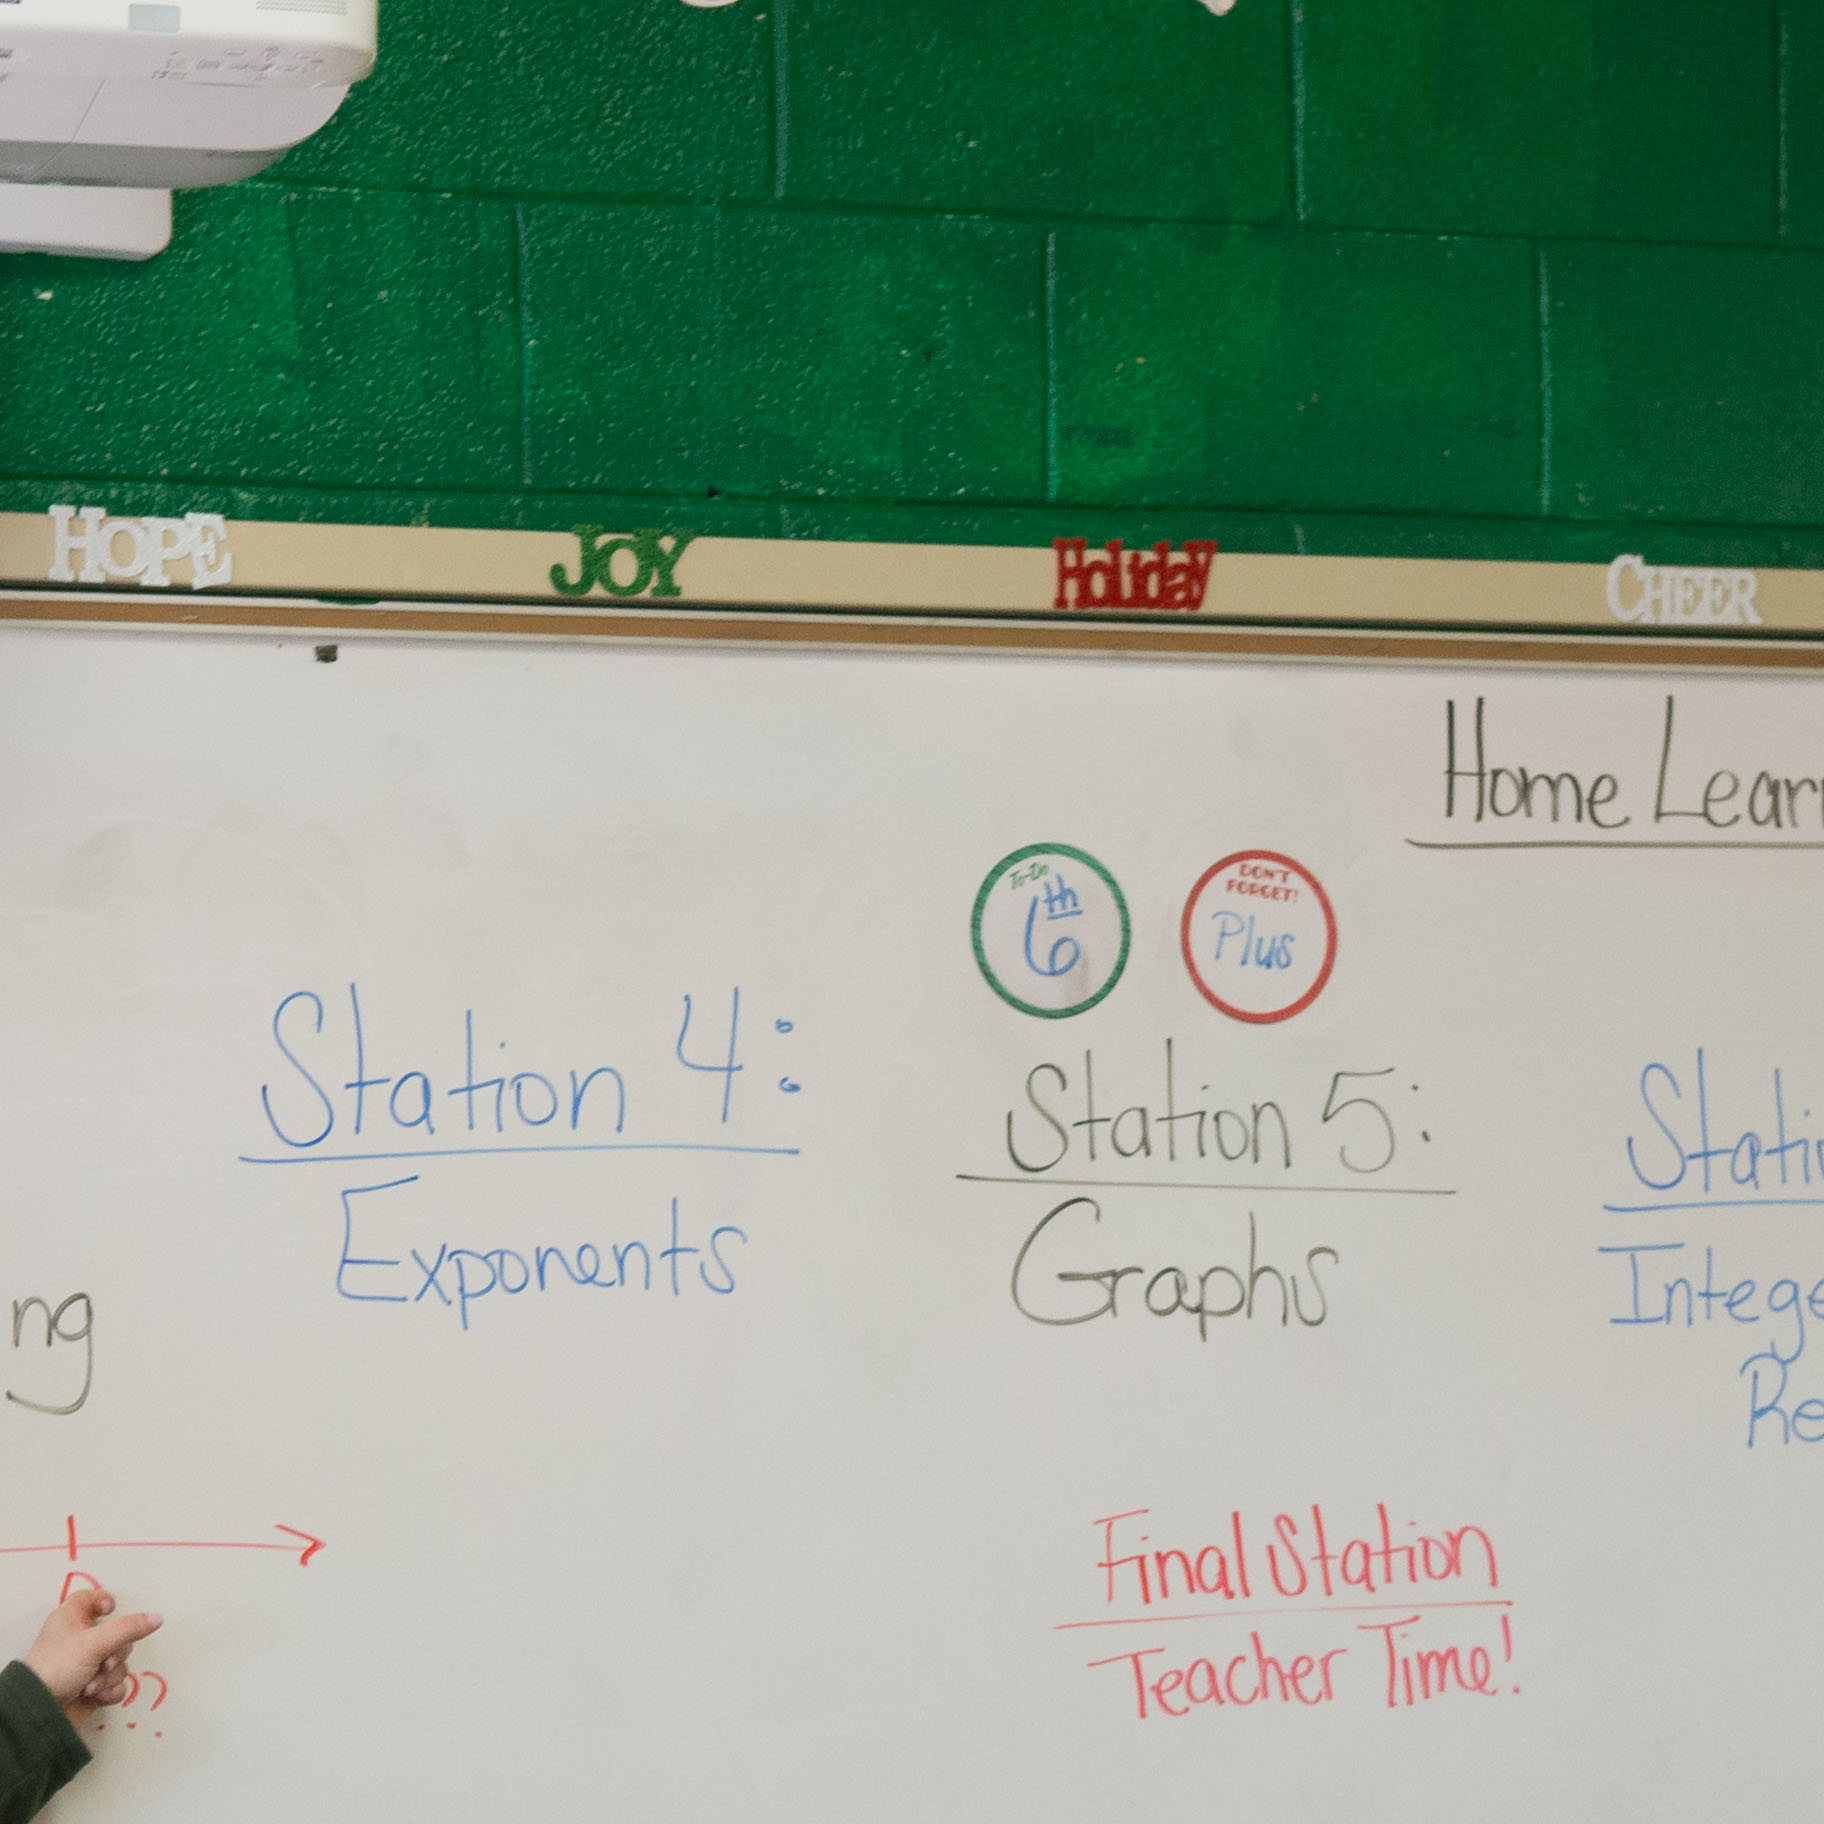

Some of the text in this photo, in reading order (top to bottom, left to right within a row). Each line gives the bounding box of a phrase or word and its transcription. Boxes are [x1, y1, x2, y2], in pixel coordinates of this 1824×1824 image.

[48, 505, 233, 591] HOPE
[549, 523, 701, 600] JOY
[1444, 696, 1631, 830] Home
[1238, 863, 1293, 884] DON'T
[1211, 910, 1296, 970] Plus
[261, 981, 802, 1149] Station 4:
[1005, 1036, 1432, 1175] Station 5:
[334, 1174, 749, 1332] Exponents
[1010, 1196, 1340, 1343] Graphs
[1093, 1501, 1500, 1606] Final Station
[1086, 1613, 1523, 1720] Teacher Time!
